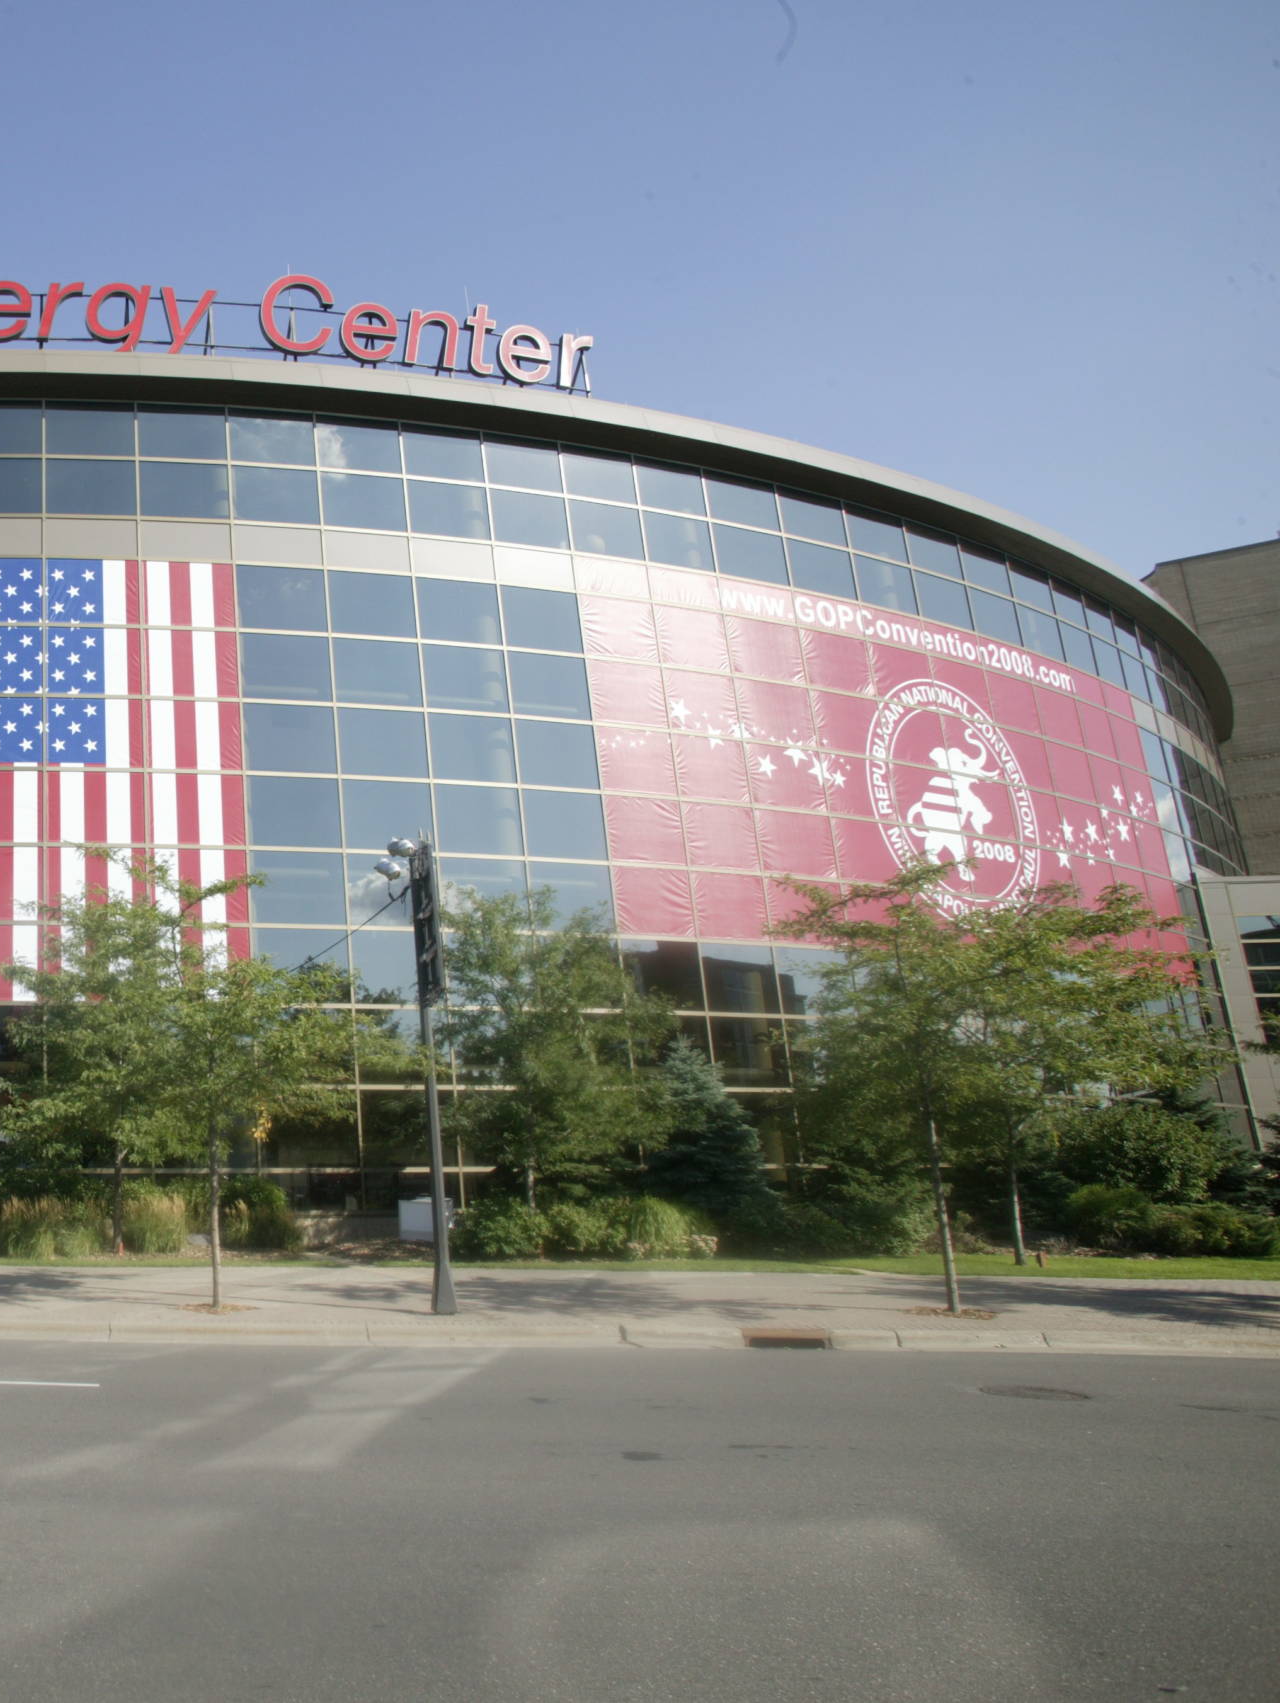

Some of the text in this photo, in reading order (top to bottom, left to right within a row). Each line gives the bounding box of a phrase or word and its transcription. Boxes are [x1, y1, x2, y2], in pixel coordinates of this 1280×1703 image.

[260, 274, 594, 389] Center
[715, 587, 1076, 694] www.GOPConvention2008.com
[871, 685, 1036, 839] REPUBLICAN NATIONAL CONVENTION
[972, 839, 1016, 863] 2008
